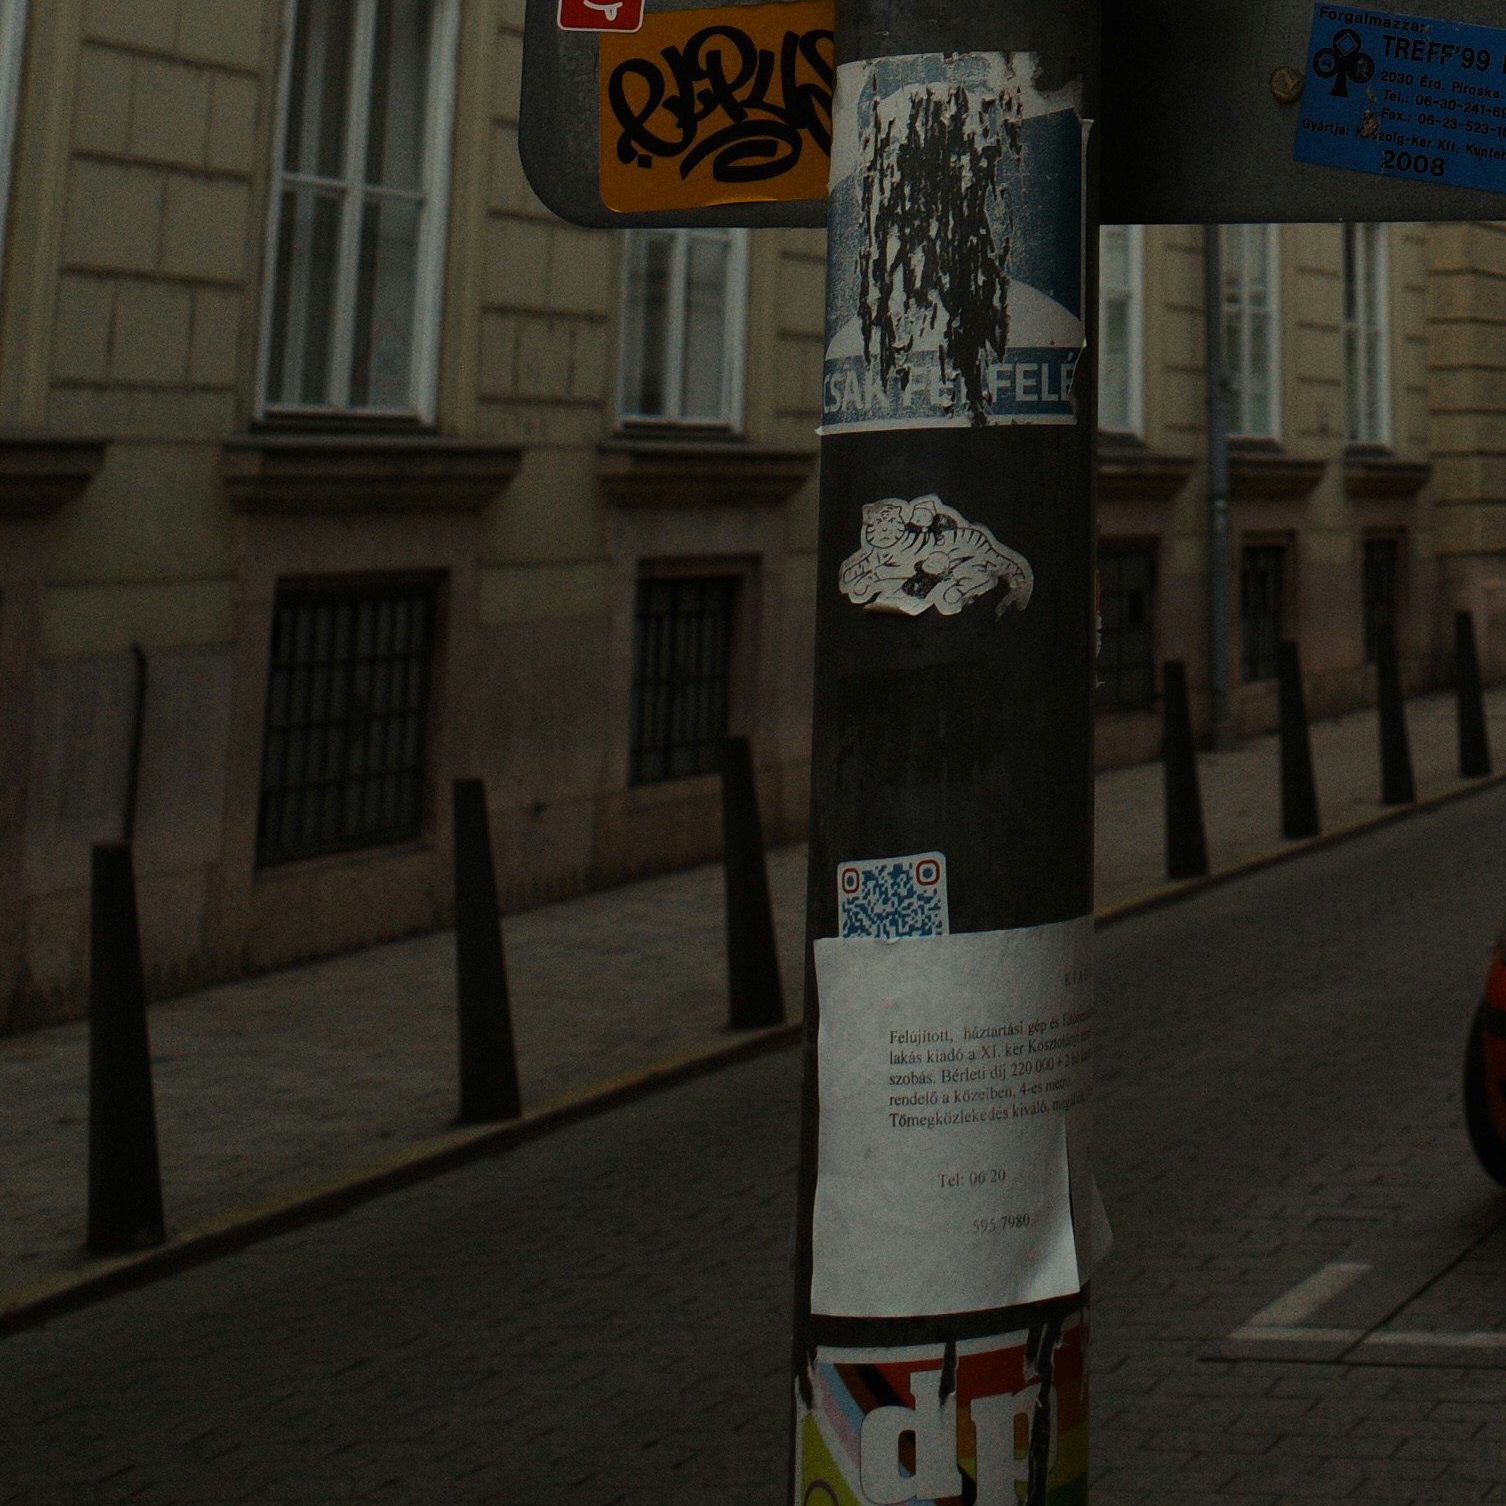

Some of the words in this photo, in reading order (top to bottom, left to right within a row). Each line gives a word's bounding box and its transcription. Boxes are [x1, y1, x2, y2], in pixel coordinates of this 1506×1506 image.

[1319, 5, 1426, 34] Forgalmazza:
[1381, 34, 1491, 72] TREFF'99
[1380, 70, 1414, 86] 2030
[1451, 80, 1501, 99] Piroska
[1301, 117, 1351, 136] Gyártja:
[1380, 148, 1446, 177] 2008
